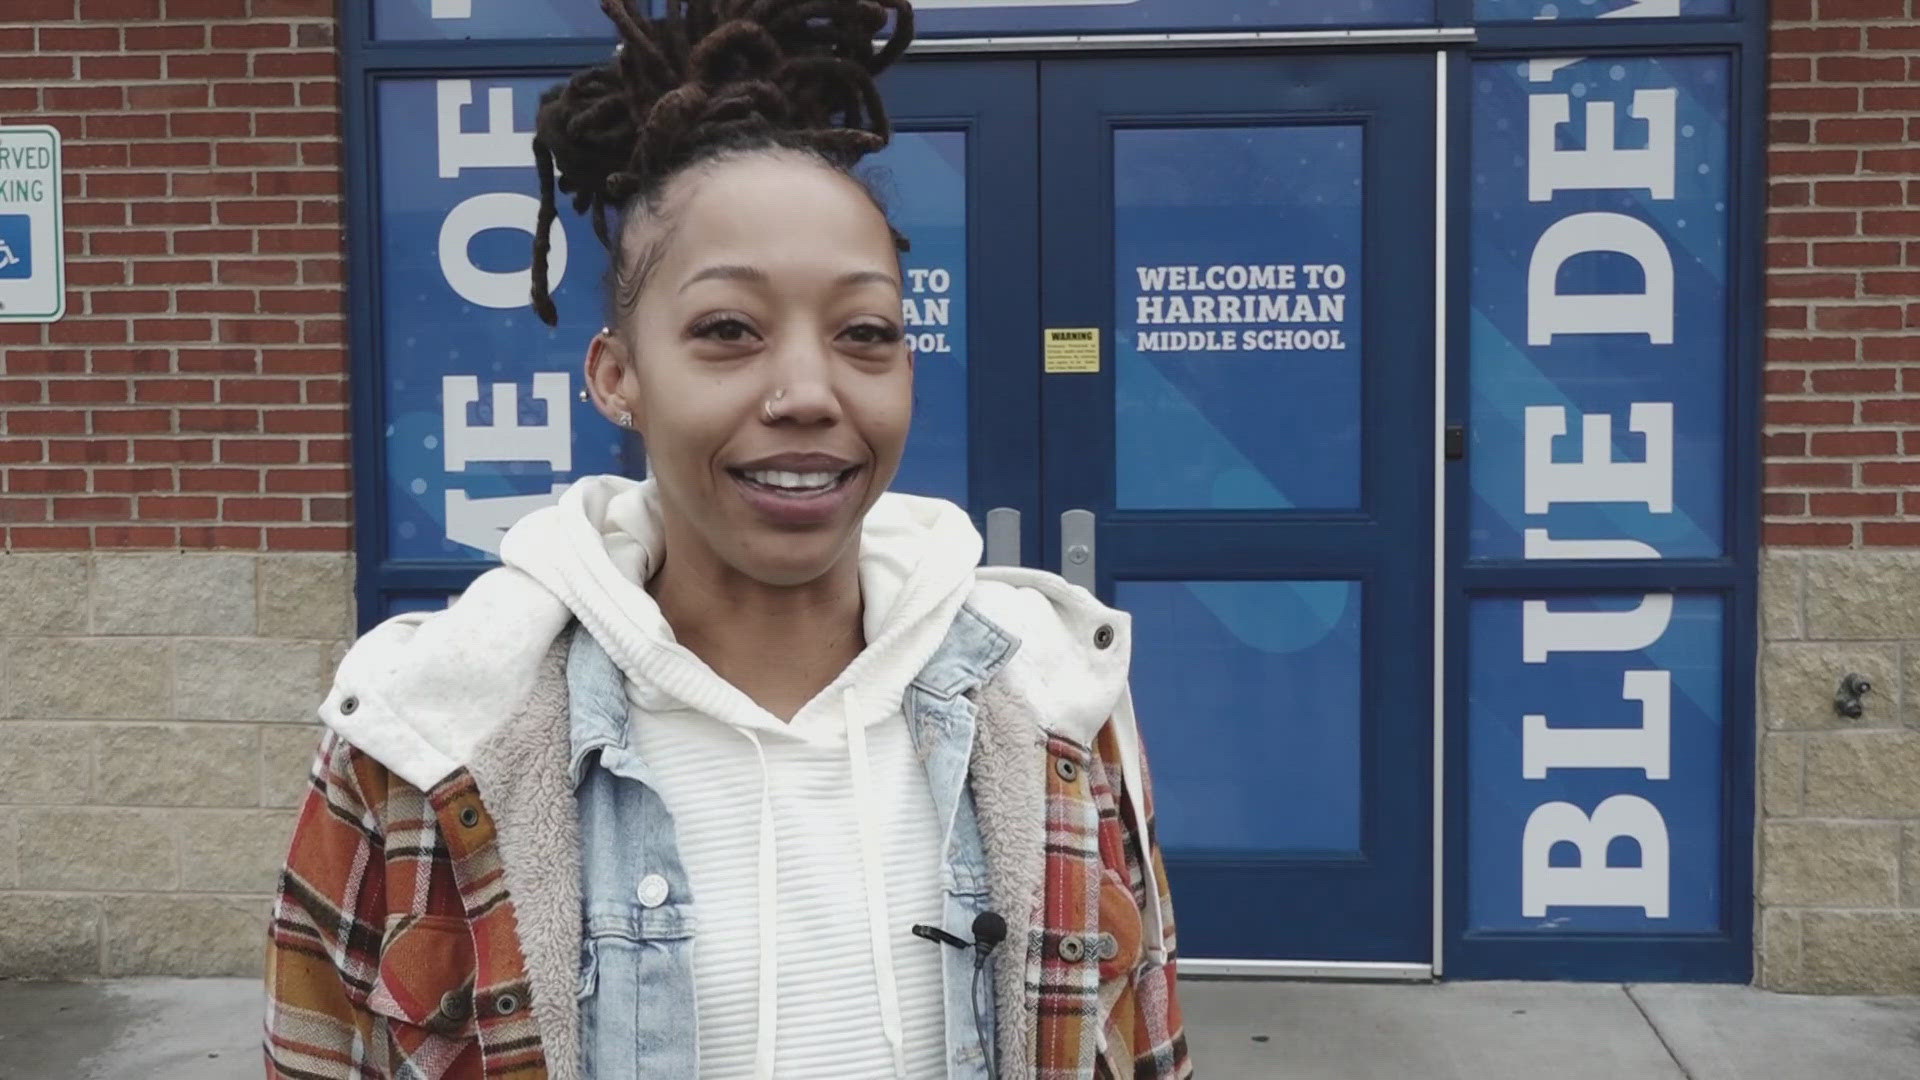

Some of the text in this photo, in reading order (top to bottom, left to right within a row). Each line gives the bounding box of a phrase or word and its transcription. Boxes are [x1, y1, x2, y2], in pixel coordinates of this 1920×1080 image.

[0, 146, 50, 170] RVED
[436, 78, 568, 309] OF
[907, 268, 951, 293] TO
[1136, 264, 1346, 291] WELCOME TO
[1136, 294, 1345, 324] HARRIMAN
[1136, 329, 1345, 351] MIDDLE SCHOOL
[1521, 402, 1674, 918] BLUE
